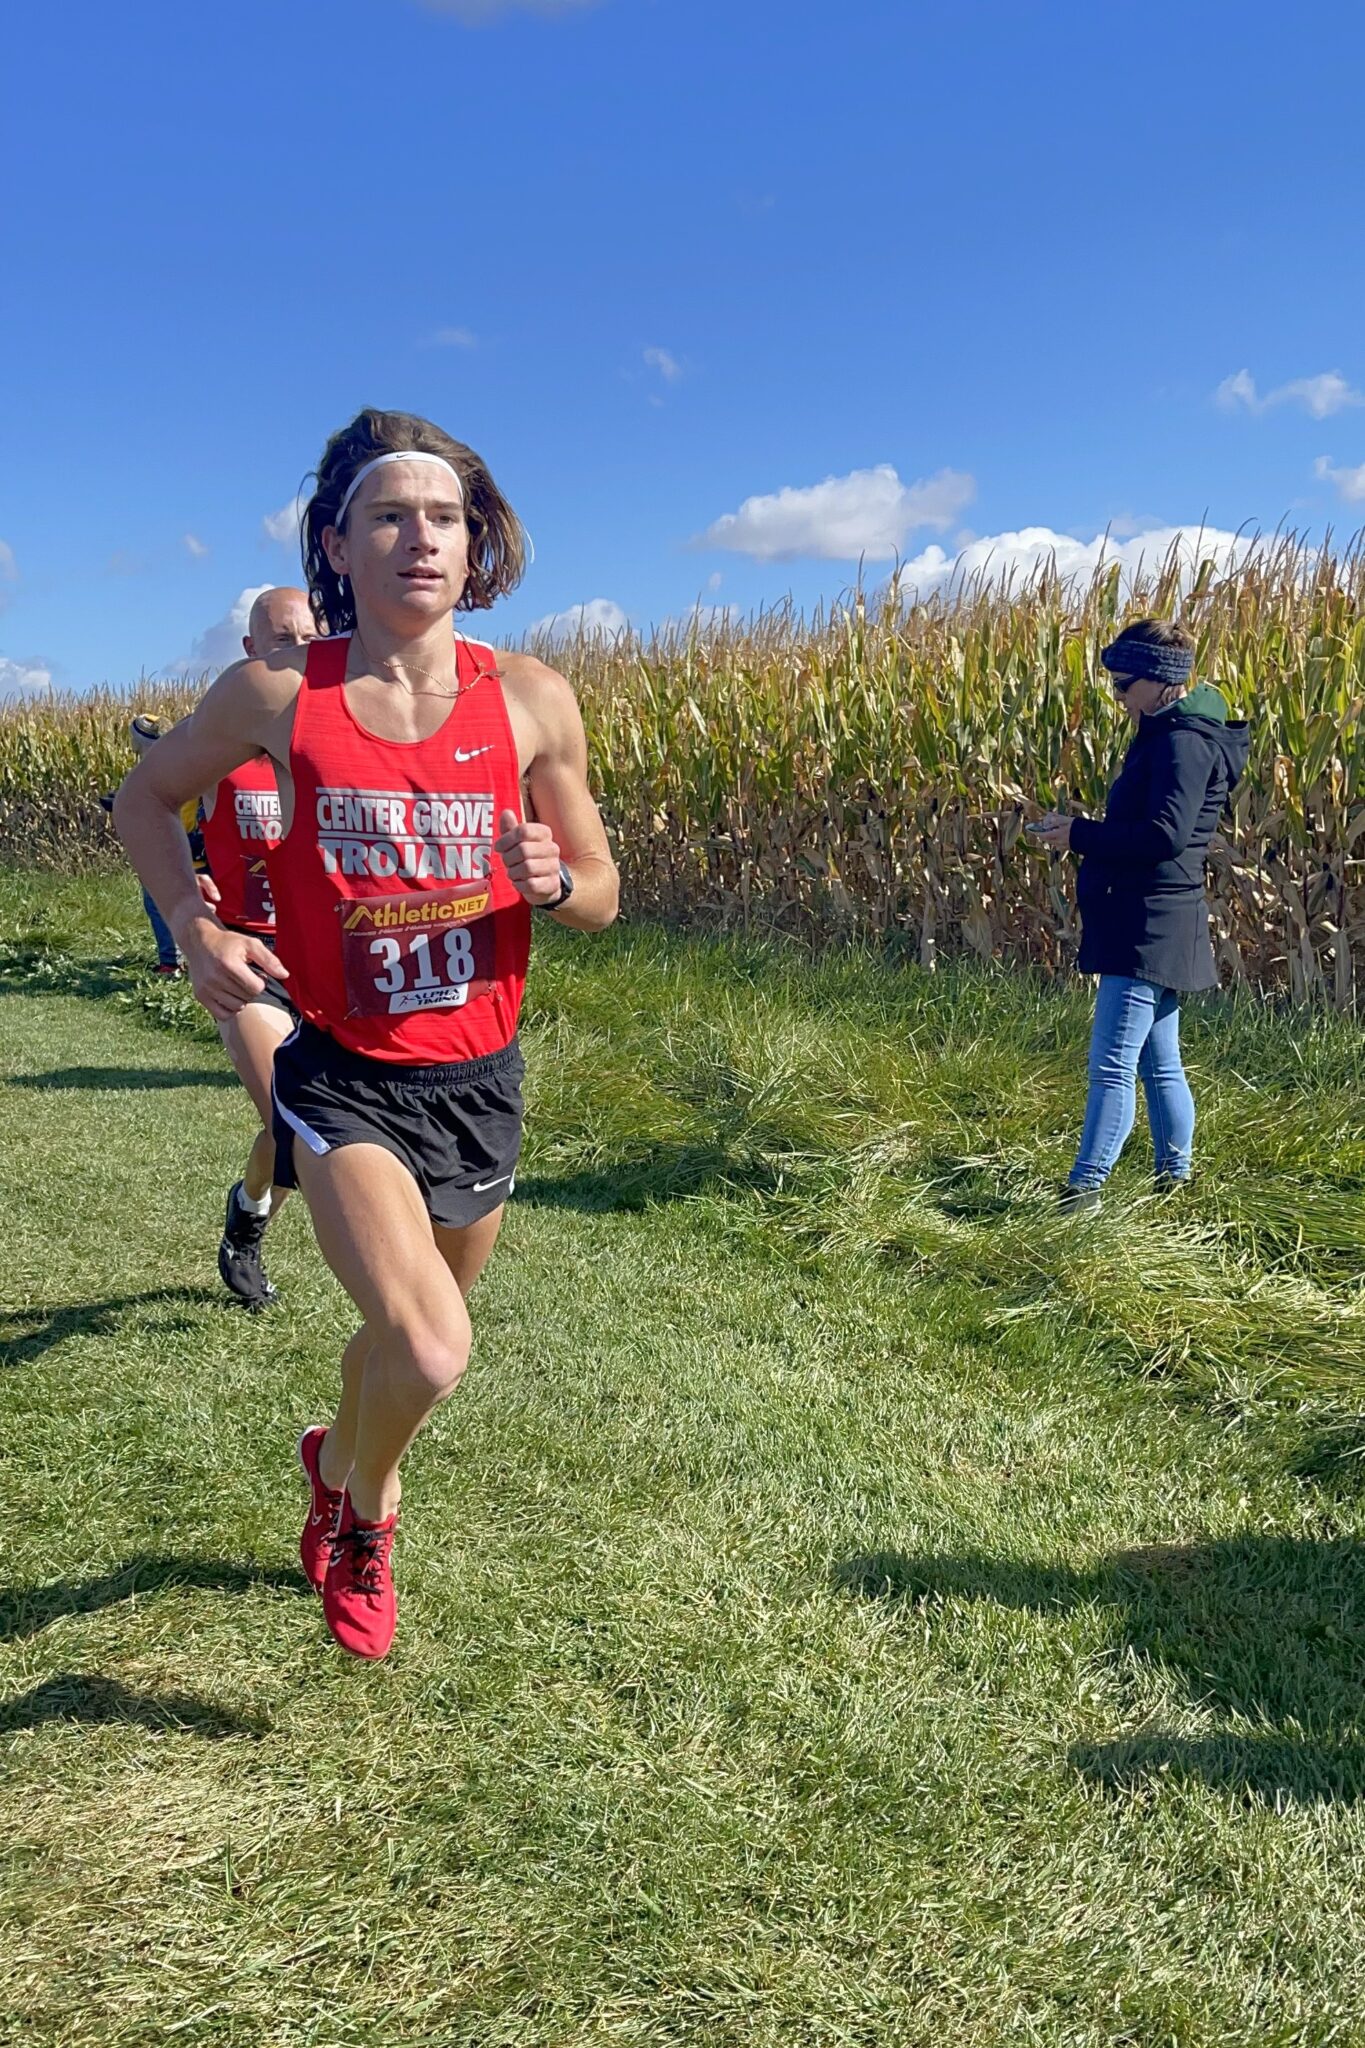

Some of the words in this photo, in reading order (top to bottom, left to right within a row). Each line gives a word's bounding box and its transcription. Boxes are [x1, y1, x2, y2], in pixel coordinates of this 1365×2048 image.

[316, 794, 408, 835] CENTER
[412, 800, 494, 837] GROVE
[317, 838, 492, 880] TROJANS
[370, 927, 476, 994] 318
[414, 988, 460, 1000] ALPHA
